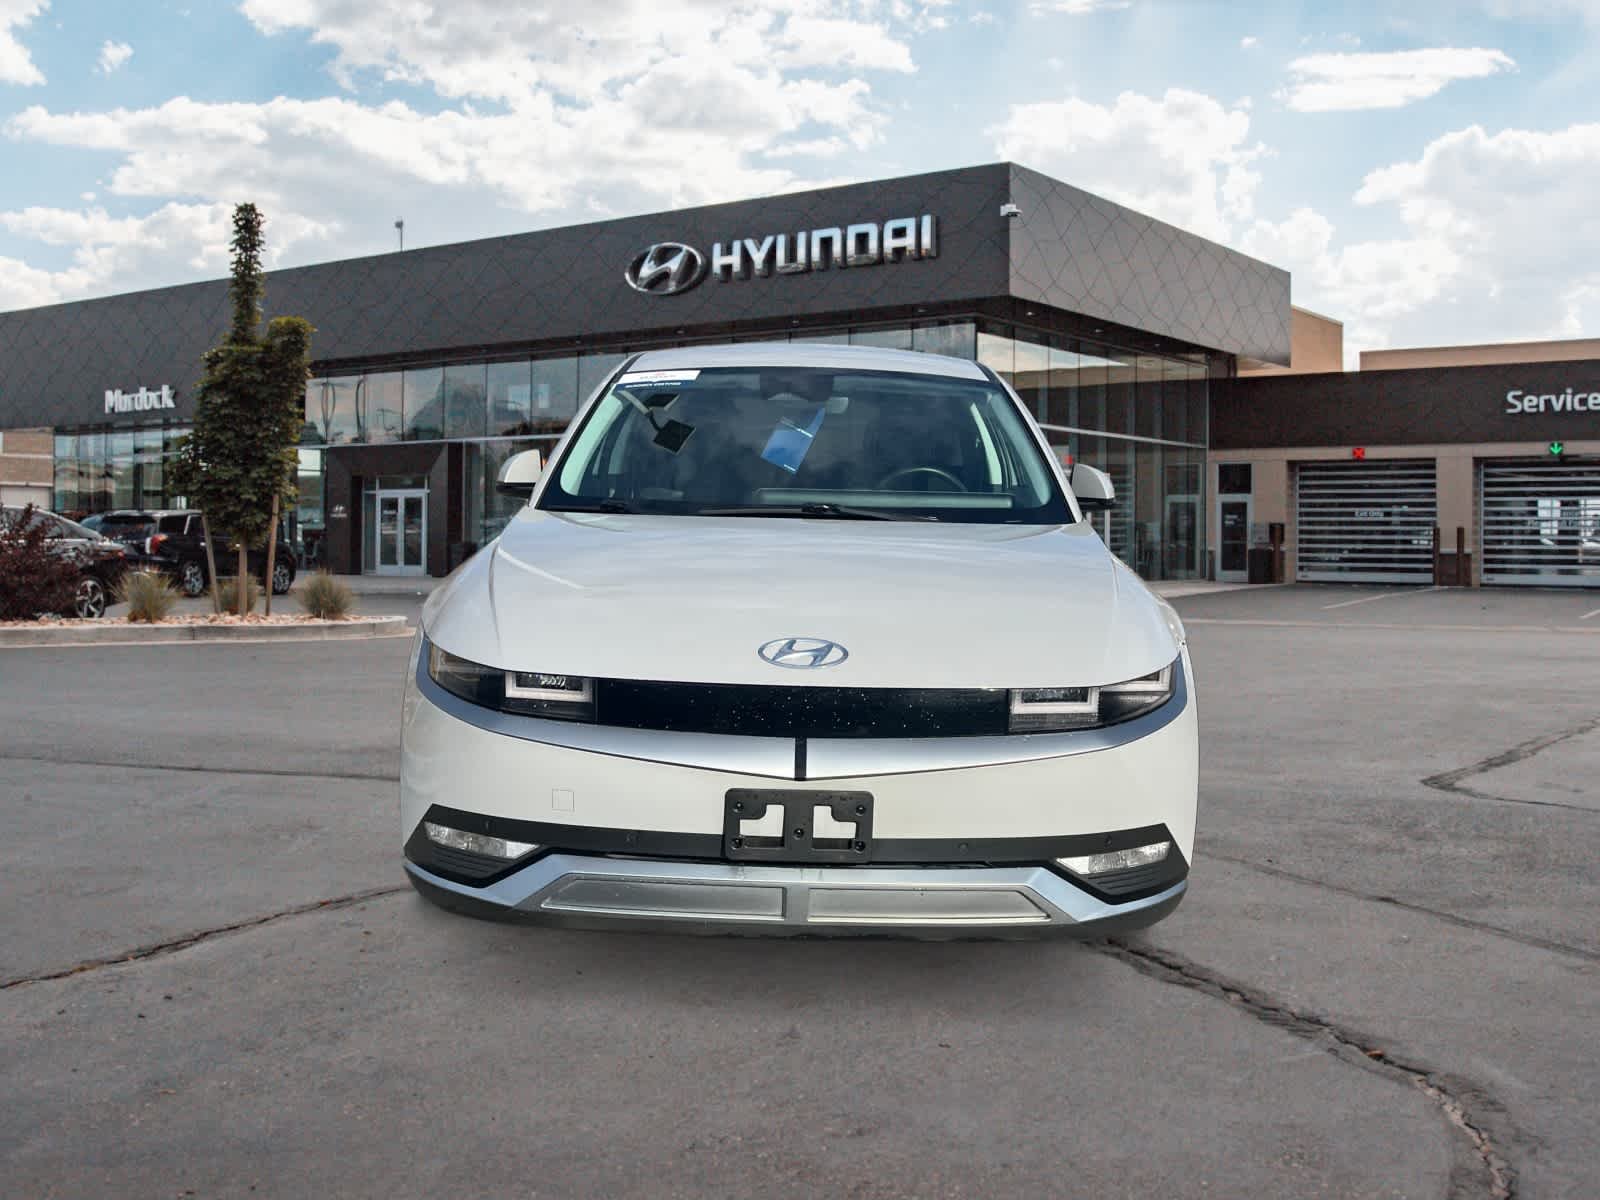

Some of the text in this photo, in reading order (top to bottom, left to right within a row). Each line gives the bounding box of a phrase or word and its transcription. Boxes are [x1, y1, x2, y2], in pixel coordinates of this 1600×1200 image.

[711, 213, 936, 281] HYUNDAI
[104, 385, 175, 413] Murdock
[1505, 388, 1600, 413] Service
